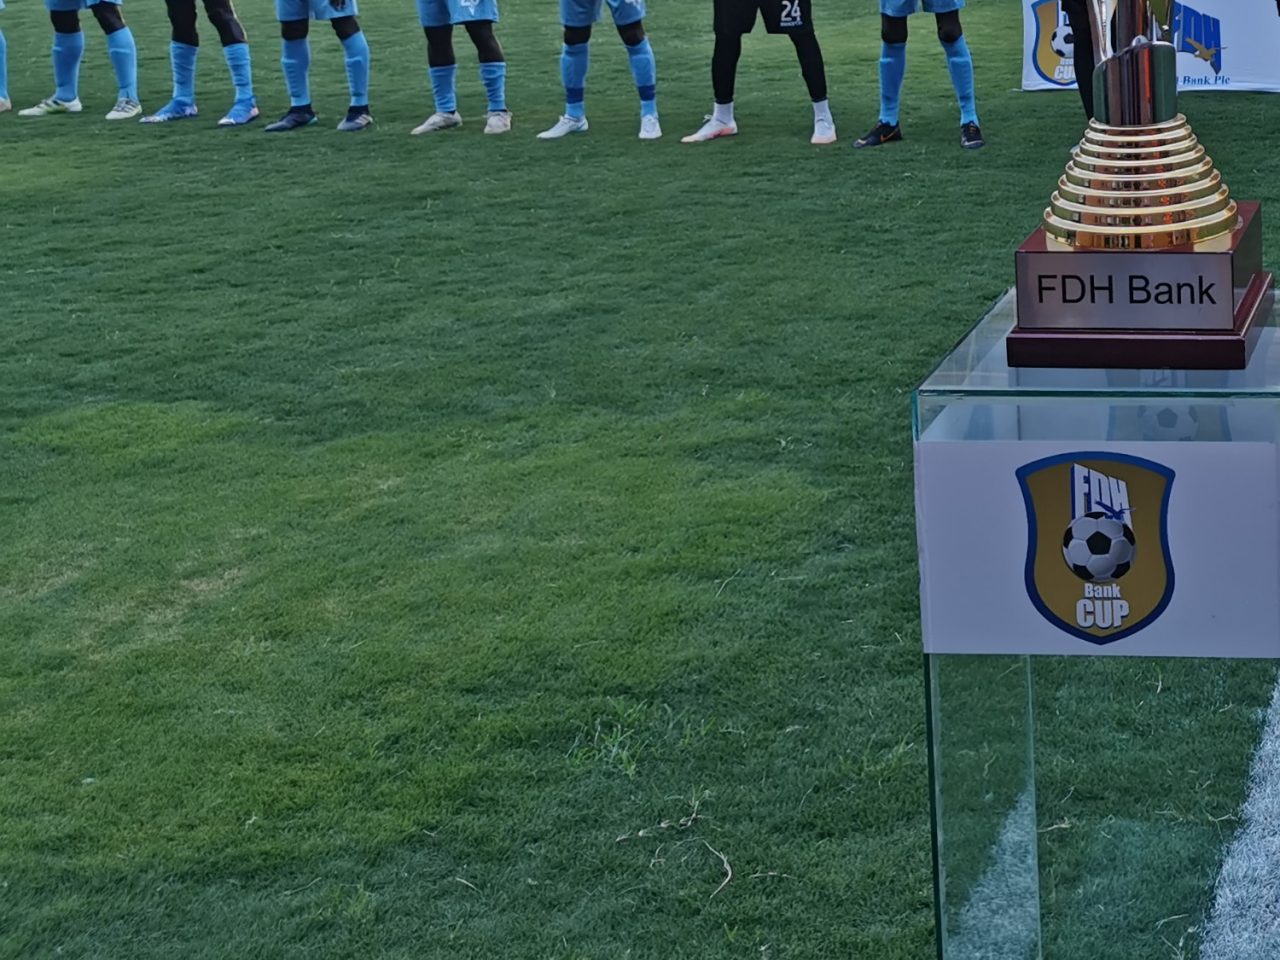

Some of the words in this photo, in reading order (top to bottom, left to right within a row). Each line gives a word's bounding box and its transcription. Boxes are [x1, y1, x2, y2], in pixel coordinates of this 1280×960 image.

[1054, 65, 1075, 80] CU
[1183, 75, 1211, 85] Bank
[1213, 75, 1231, 85] Plc
[1038, 274, 1114, 304] FDH
[1128, 275, 1217, 305] Bank
[1071, 463, 1134, 532] FDH
[1084, 583, 1121, 598] Bank
[1076, 598, 1130, 629] CUP
